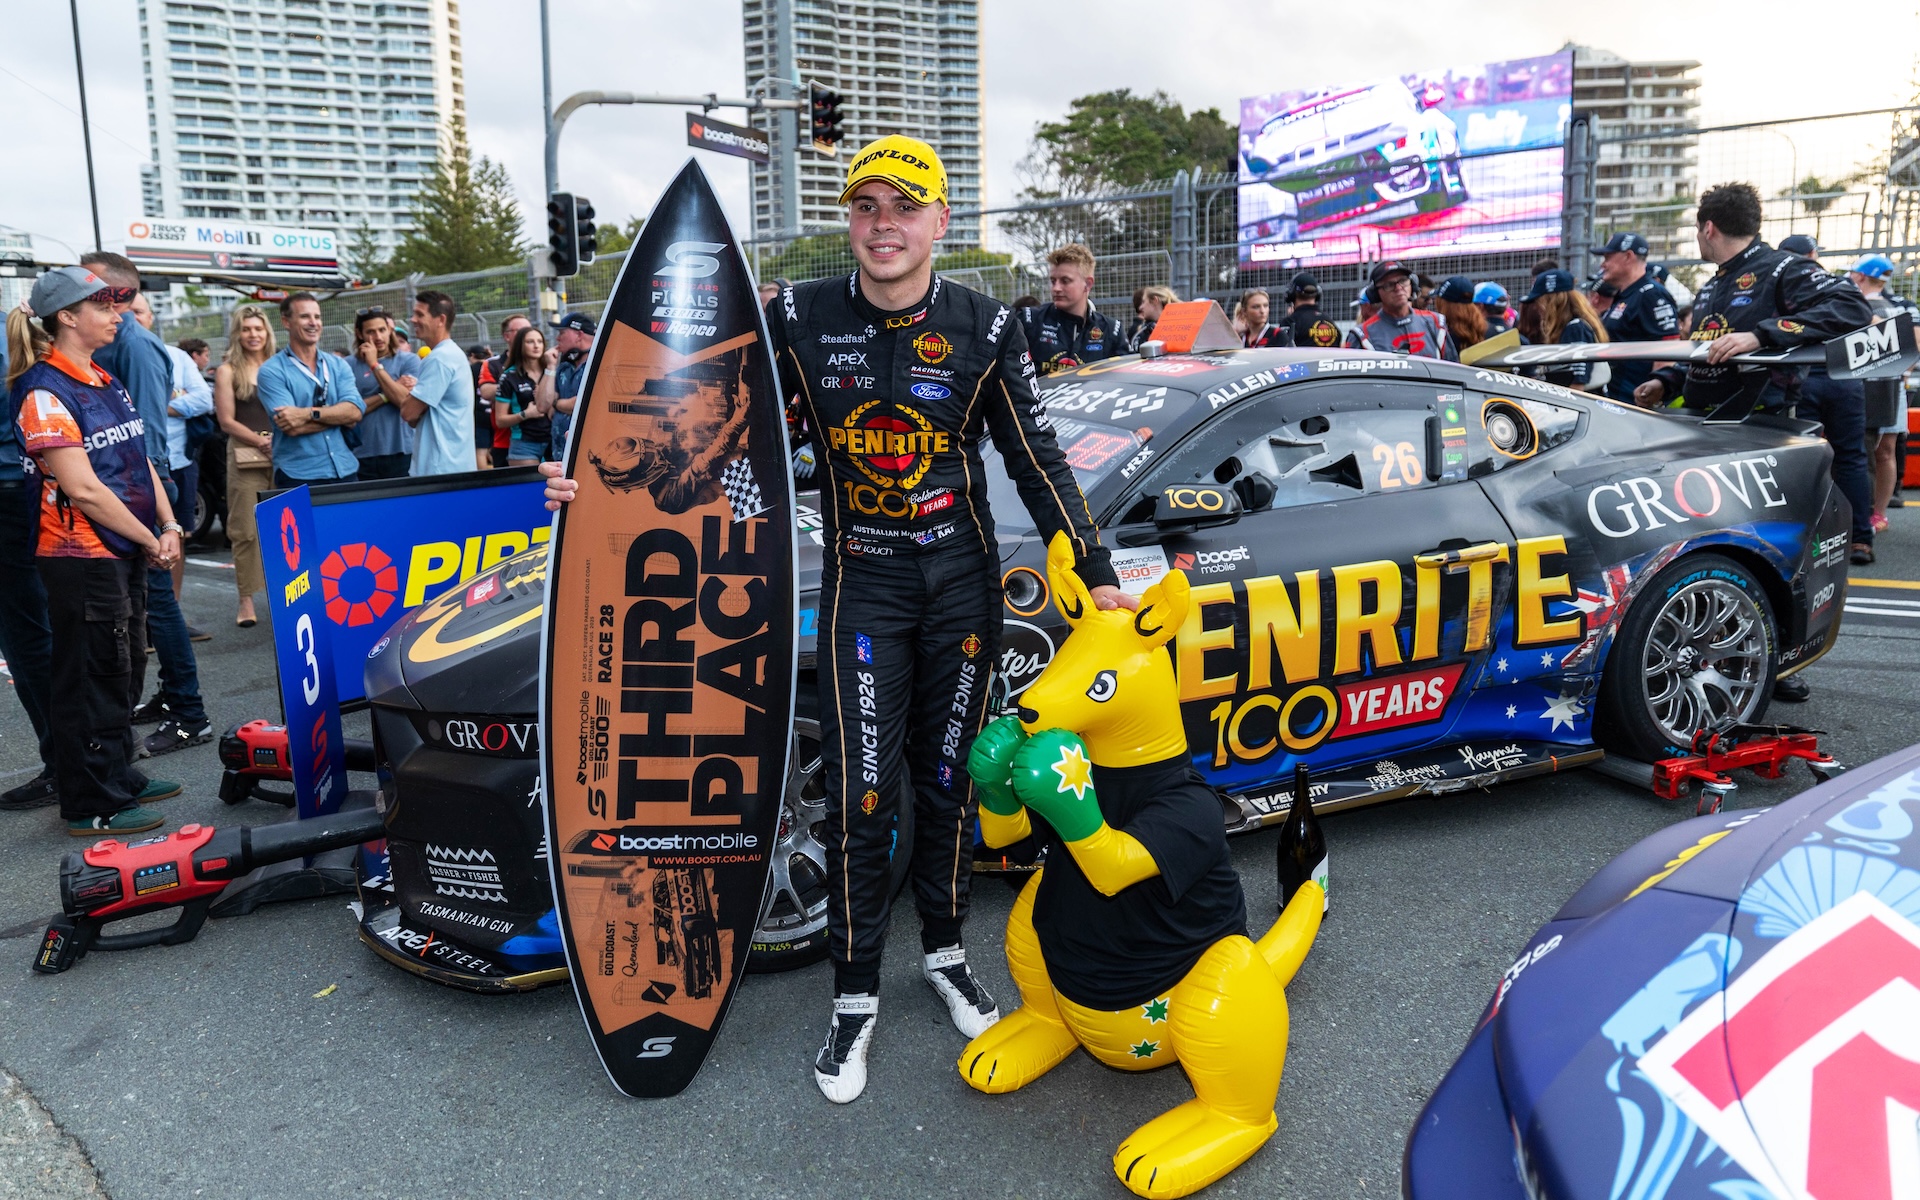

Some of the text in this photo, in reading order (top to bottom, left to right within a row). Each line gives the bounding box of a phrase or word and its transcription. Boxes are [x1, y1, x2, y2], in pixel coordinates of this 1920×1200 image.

[703, 126, 769, 154] boostmobile
[852, 150, 930, 175] DUNLOP
[150, 232, 187, 241] ASSIST
[151, 224, 187, 234] TRUCK
[197, 228, 244, 245] Mobil
[273, 234, 332, 250] OPTUS
[663, 308, 706, 319] SERIES
[783, 286, 799, 322] HRX
[666, 320, 717, 337] Repco
[986, 305, 1011, 344] HRX
[819, 333, 867, 345] Steadfast
[912, 339, 953, 355] PENRITE
[1845, 318, 1900, 370] D&M
[827, 348, 870, 370] APEX
[911, 366, 941, 375] RACING
[1208, 370, 1276, 409] ALLEN
[1495, 373, 1578, 400] AUTODESK
[26, 430, 63, 442] Queensland
[828, 427, 949, 457] PENRITE
[1443, 439, 1466, 448] FOXTEL
[1120, 445, 1156, 480] HRX
[1372, 441, 1423, 489] 26
[923, 496, 949, 513] YEARS
[1164, 488, 1223, 511] 100
[852, 524, 900, 538] AUSTRALIAN
[1112, 555, 1162, 566] boostmobile
[1195, 546, 1250, 563] boost
[1201, 561, 1236, 574] mobile
[1121, 567, 1150, 579] 500
[284, 569, 310, 608] PIRTEK
[1812, 582, 1835, 613] FORD
[1176, 533, 1583, 703] ENRITE
[598, 604, 614, 683] RACE 28
[296, 613, 321, 706] 3
[691, 515, 769, 816] PLACE
[616, 528, 698, 820] THIRD
[942, 661, 976, 760] SINCE 1926
[1210, 675, 1446, 769] 100 YEARS
[446, 719, 541, 752] GROV
[577, 690, 590, 770] boostmobile
[595, 716, 610, 762] 500
[857, 671, 878, 785] SINCE 1926
[1458, 743, 1523, 772] Haymes
[1268, 783, 1329, 806] VELITY
[620, 833, 758, 850] boostmobile
[429, 865, 461, 880] DASHER
[468, 870, 502, 882] FISHER
[653, 854, 762, 865] WWW.BOOST.COM.AU
[419, 901, 514, 934] TASMANIAN GIN
[377, 925, 496, 974] APEX STEEL
[621, 920, 640, 978] Queensland
